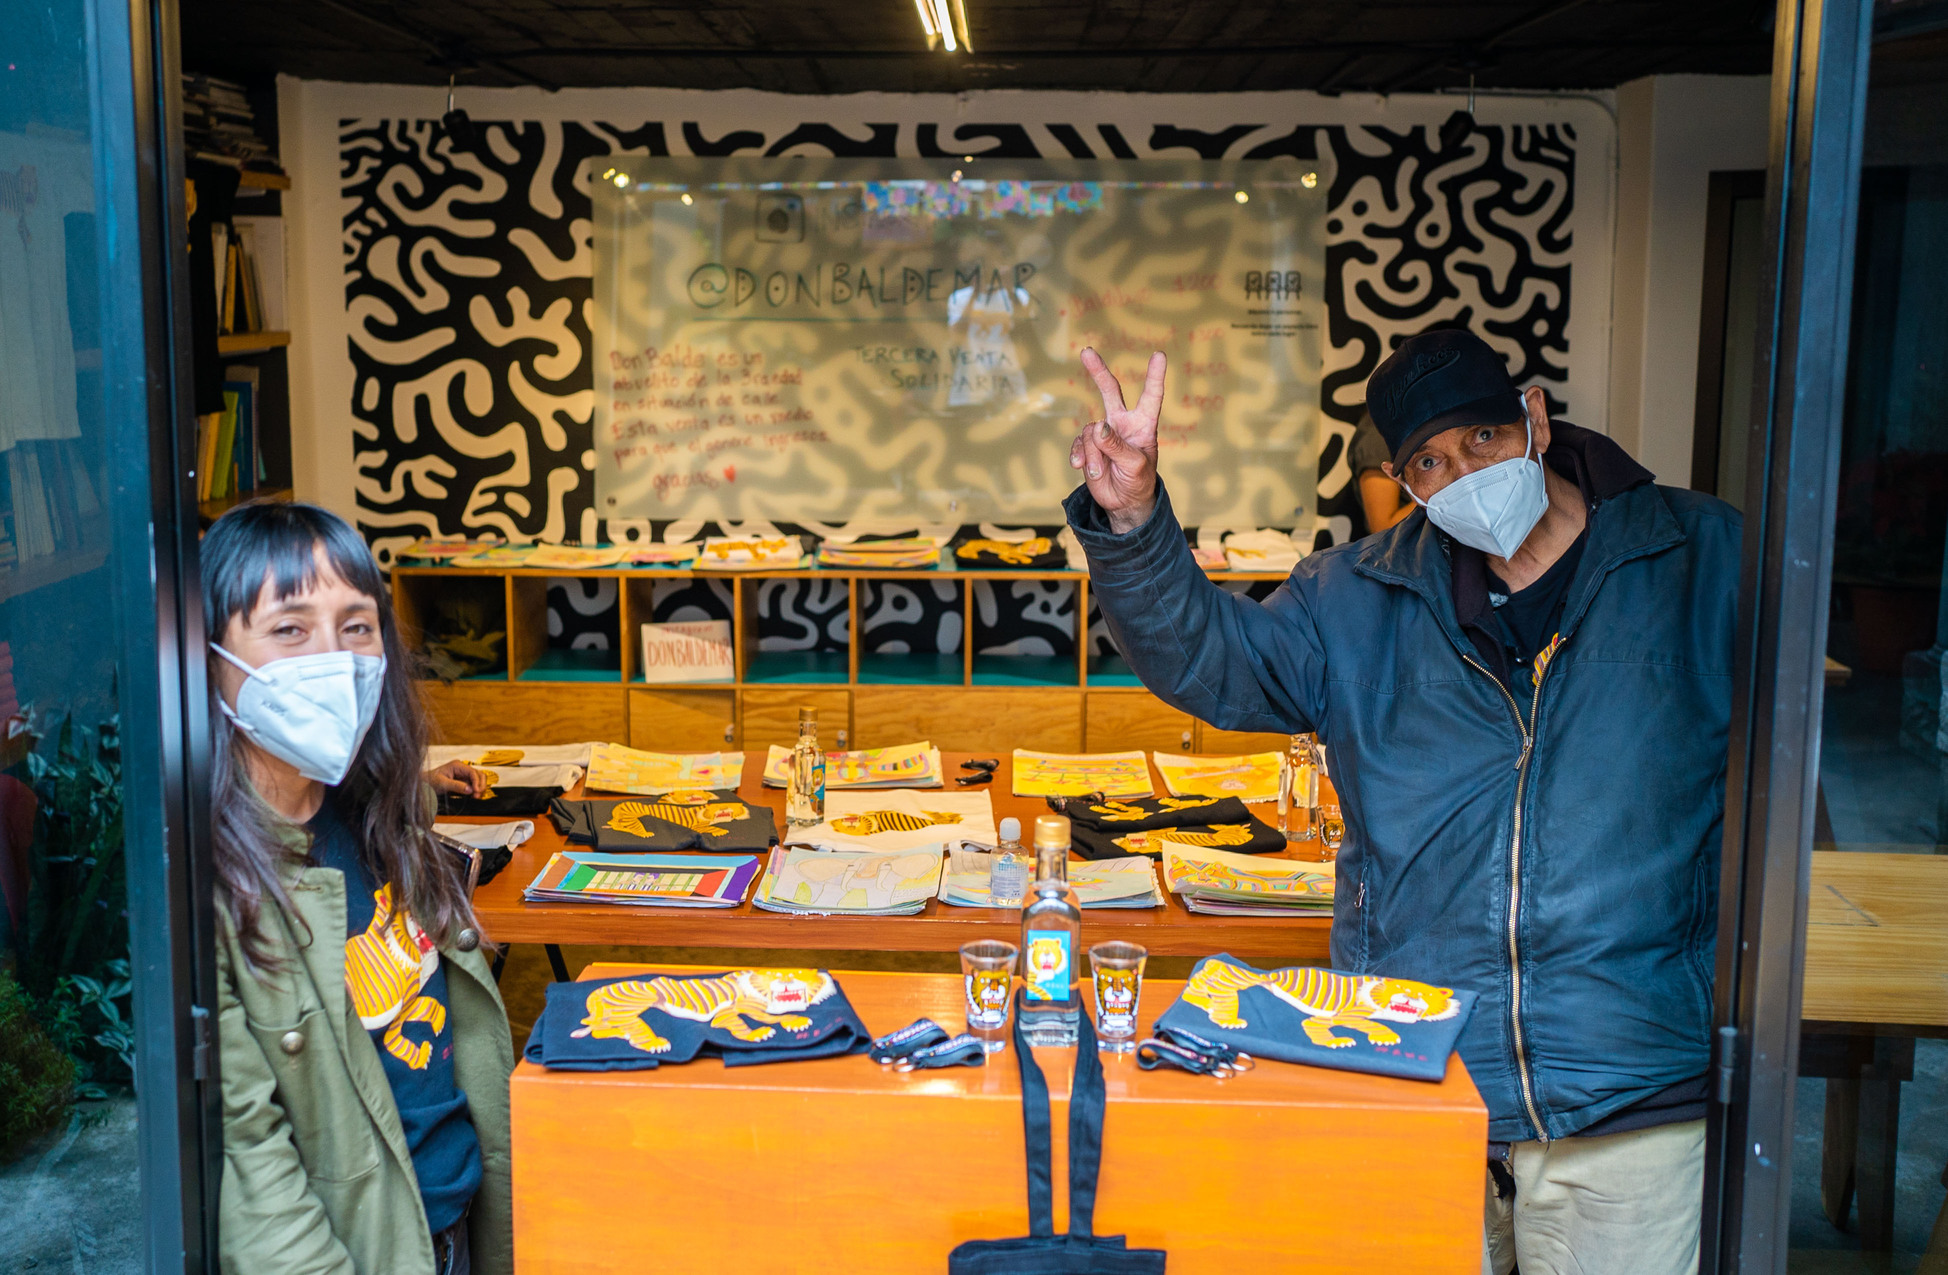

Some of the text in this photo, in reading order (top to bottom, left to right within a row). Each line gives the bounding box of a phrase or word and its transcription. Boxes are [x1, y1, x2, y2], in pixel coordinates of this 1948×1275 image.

[687, 262, 1037, 310] @DONBALDEMAR
[610, 351, 642, 370] Don
[717, 352, 739, 367] es
[743, 352, 763, 367] un
[851, 344, 1012, 366] TERCERA VENTA
[686, 373, 709, 389] de
[716, 369, 731, 384] la
[612, 420, 659, 440] Esta
[717, 413, 736, 427] es
